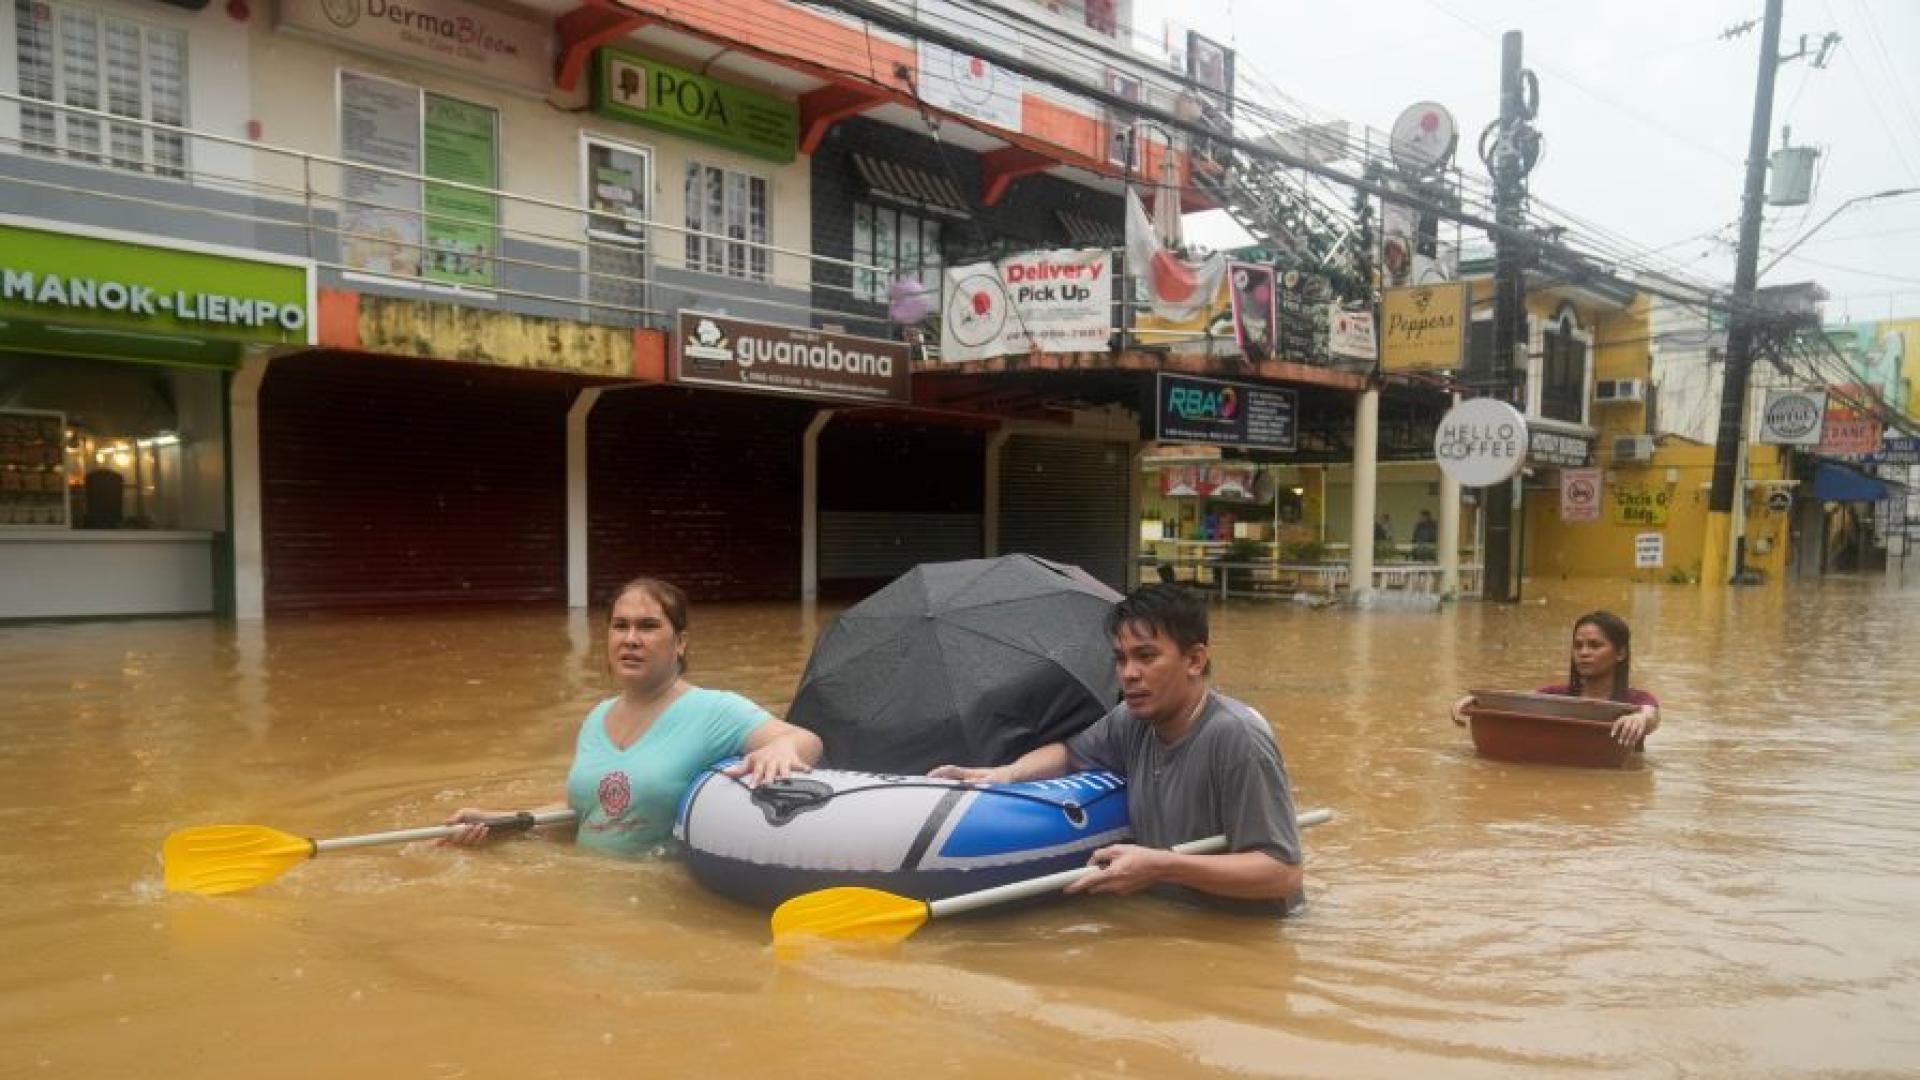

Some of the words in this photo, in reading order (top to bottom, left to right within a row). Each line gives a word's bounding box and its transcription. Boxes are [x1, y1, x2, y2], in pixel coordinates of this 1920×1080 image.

[656, 70, 730, 126] POA
[1007, 261, 1104, 283] Delivery
[2, 268, 155, 315] MANOK
[177, 290, 306, 331] LIEMPO
[1018, 286, 1055, 302] Pick
[1061, 284, 1091, 302] Up
[1387, 312, 1455, 340] Peppers
[736, 336, 893, 378] guanabana
[1443, 423, 1515, 440] HELLO
[1439, 440, 1516, 460] COFFEE
